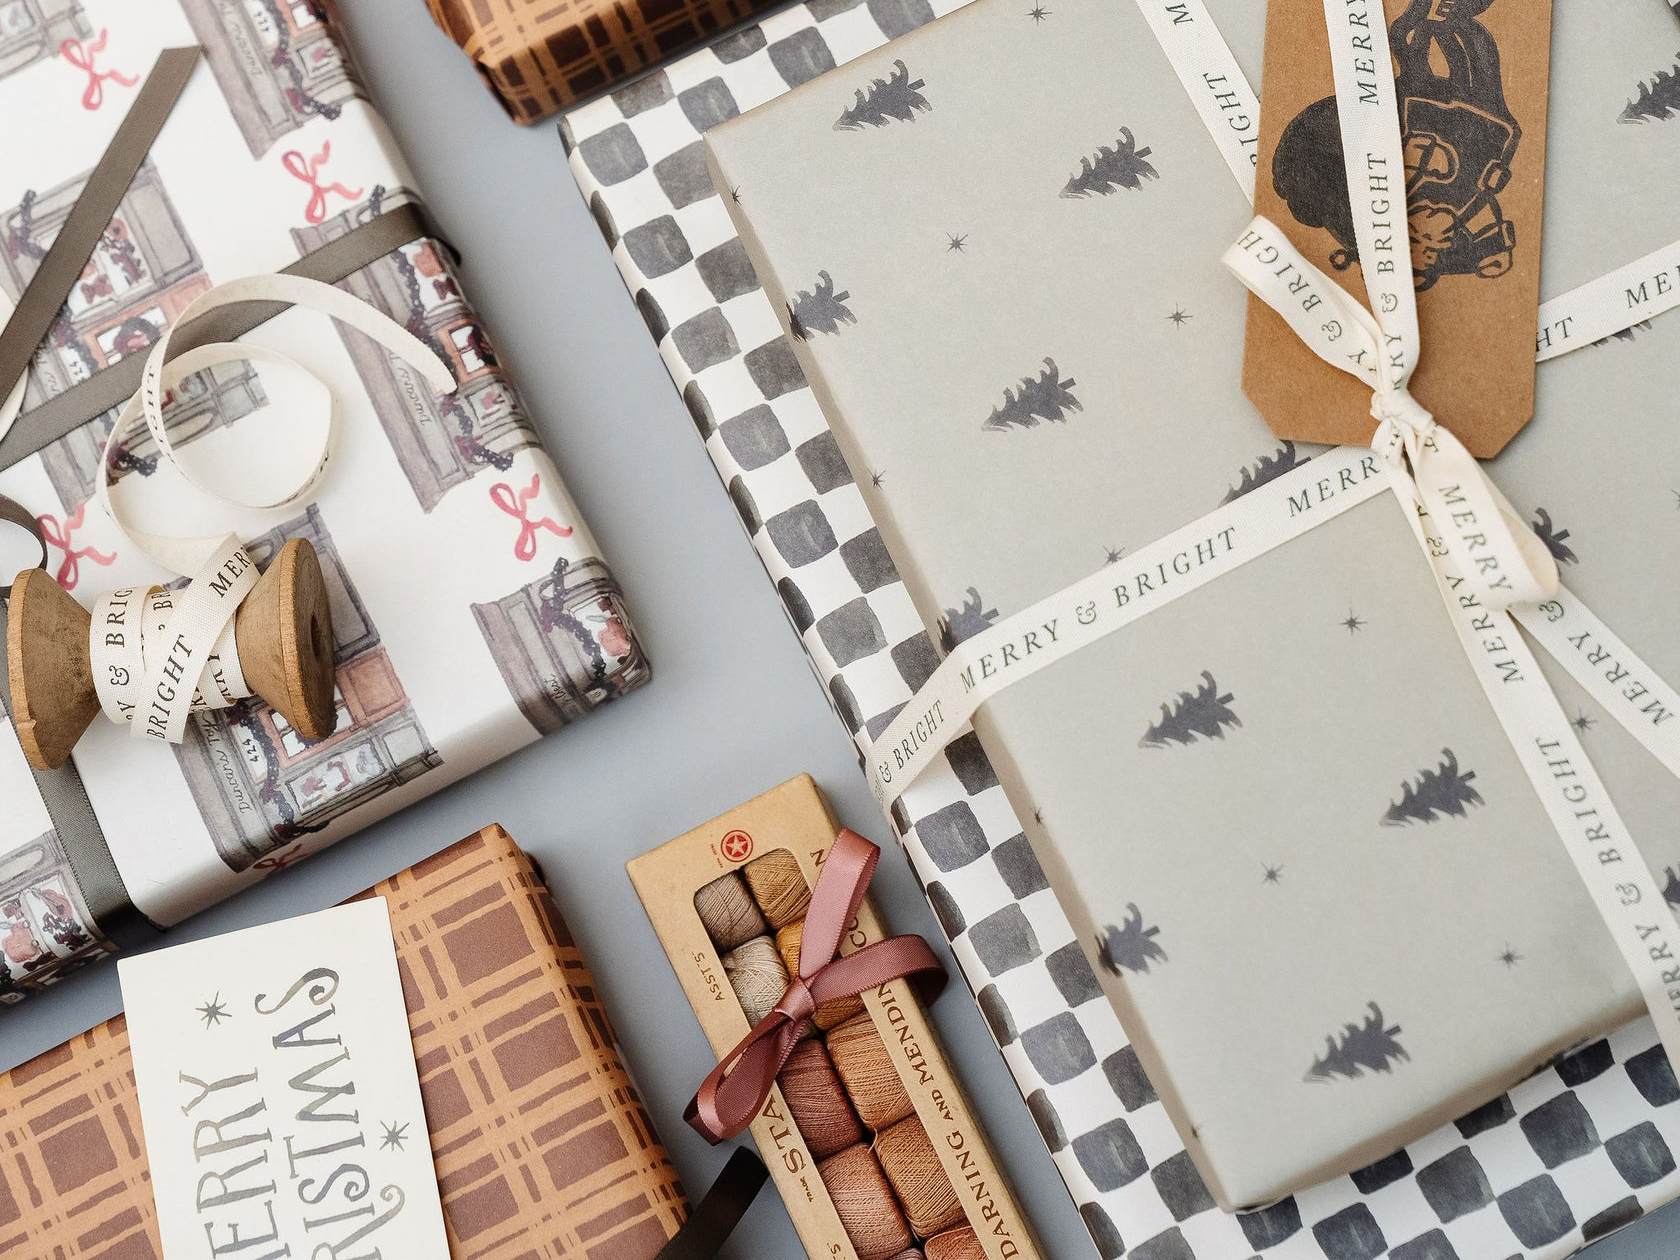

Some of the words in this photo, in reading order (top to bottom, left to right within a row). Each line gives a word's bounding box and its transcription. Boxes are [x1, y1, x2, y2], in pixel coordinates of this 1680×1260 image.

[1366, 152, 1395, 276] BRIGHT
[1320, 320, 1343, 342] &
[1381, 292, 1398, 314] &
[1438, 483, 1514, 591] MERRY
[878, 761, 893, 783] &
[893, 699, 945, 771] BRIGHT
[959, 619, 1060, 694] MERRY
[1075, 601, 1098, 626] &
[1113, 527, 1237, 608] BRIGHT
[1445, 574, 1524, 684] MERRY
[1538, 600, 1565, 623] &
[108, 665, 130, 686] &
[146, 634, 193, 740] BRIGHT
[1567, 630, 1674, 726] MERRY
[241, 738, 260, 762] 424
[1535, 736, 1623, 865] BRIGHT
[1615, 882, 1642, 907] &
[931, 1088, 954, 1122] AND
[178, 1066, 291, 1260] ERRY
[945, 1130, 1019, 1260] DARNING
